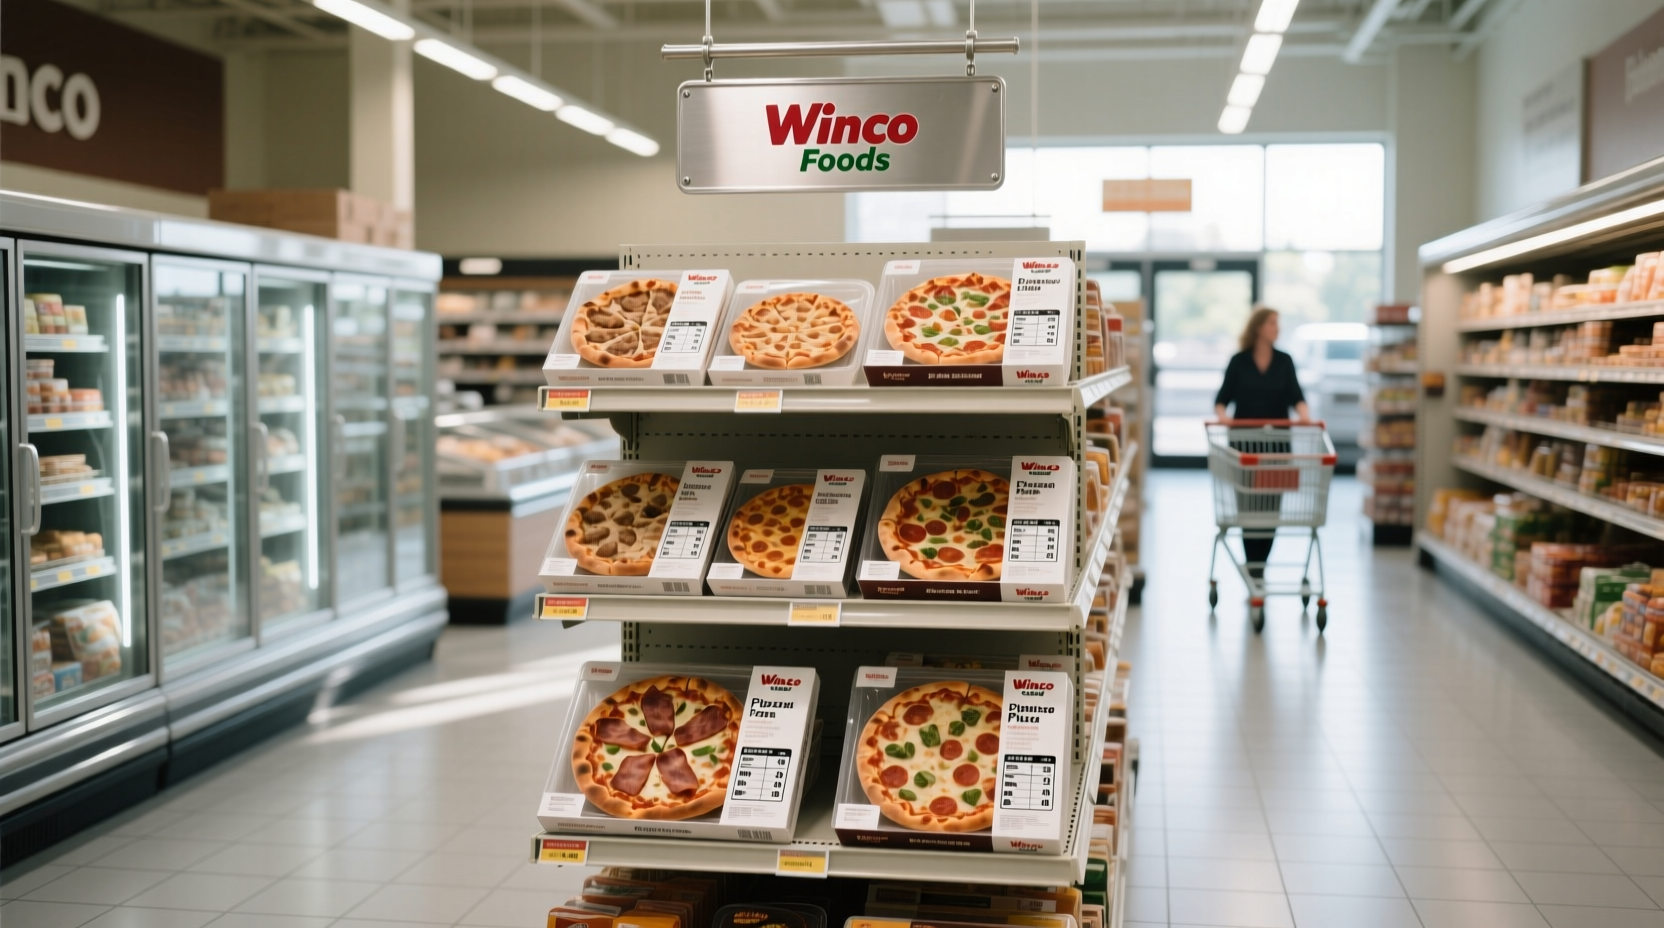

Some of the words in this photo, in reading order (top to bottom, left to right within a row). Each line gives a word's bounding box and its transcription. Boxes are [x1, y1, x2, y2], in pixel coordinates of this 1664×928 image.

[766, 103, 919, 145] Winco
[800, 147, 890, 172] Foods
[1013, 679, 1054, 690] Winco
